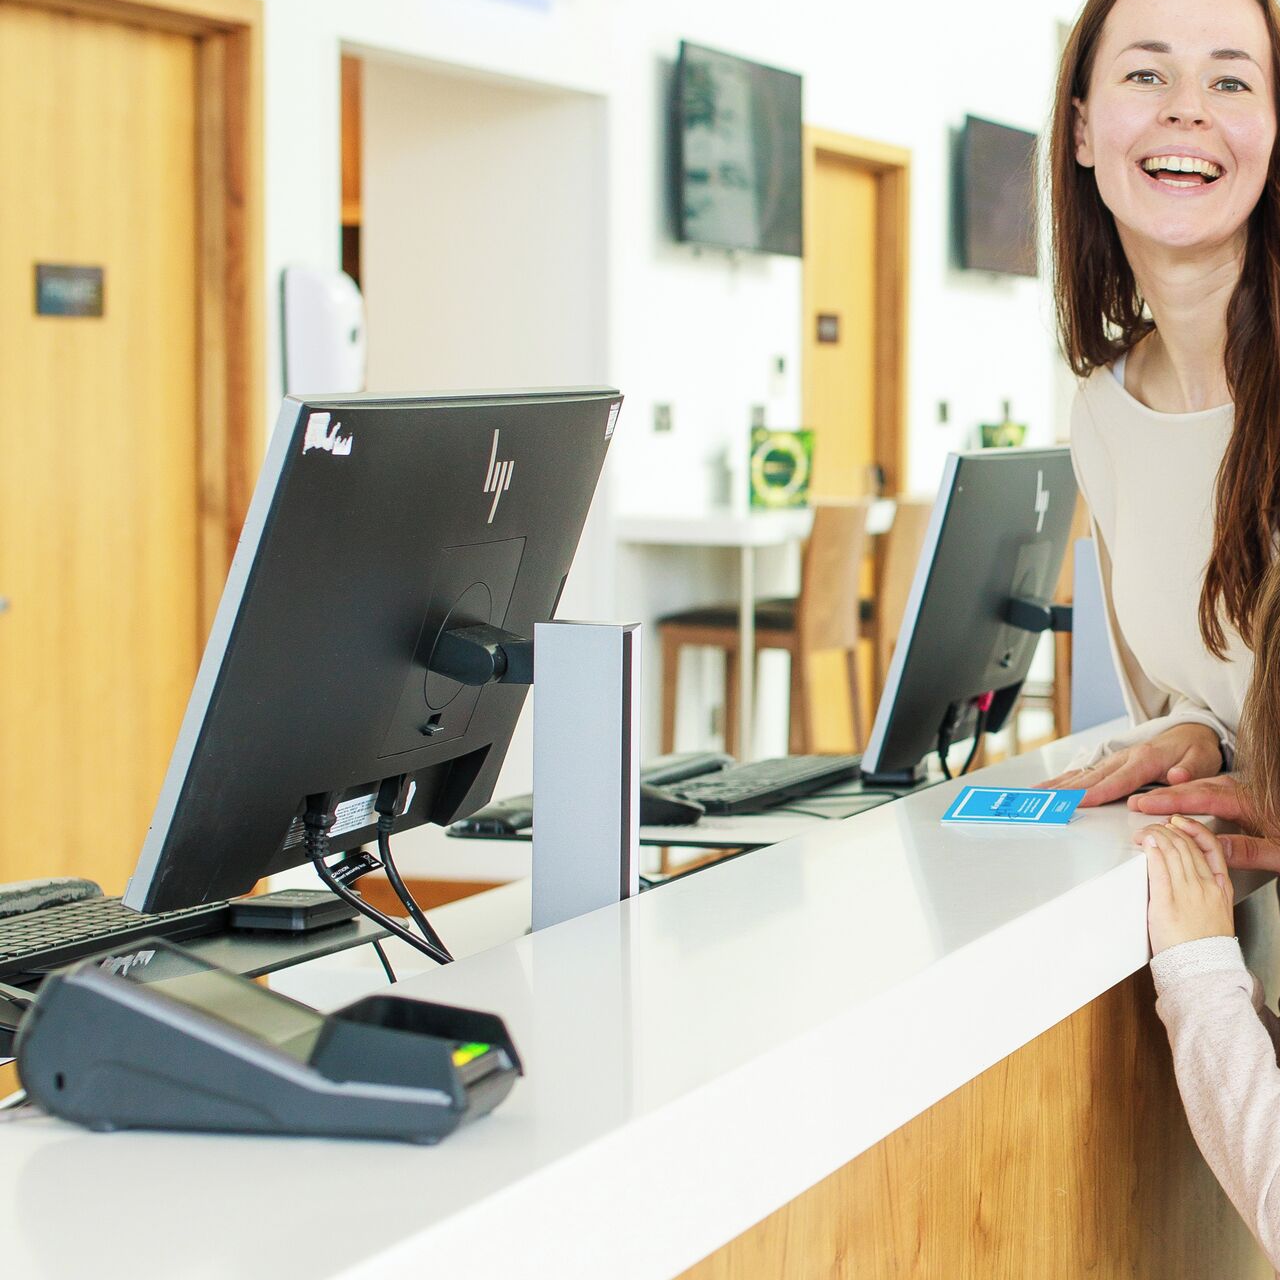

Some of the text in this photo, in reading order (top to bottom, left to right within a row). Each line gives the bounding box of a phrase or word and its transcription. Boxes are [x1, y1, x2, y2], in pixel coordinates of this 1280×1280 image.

[483, 428, 515, 524] hp
[1034, 469, 1050, 533] hp
[330, 865, 350, 879] CAUTION
